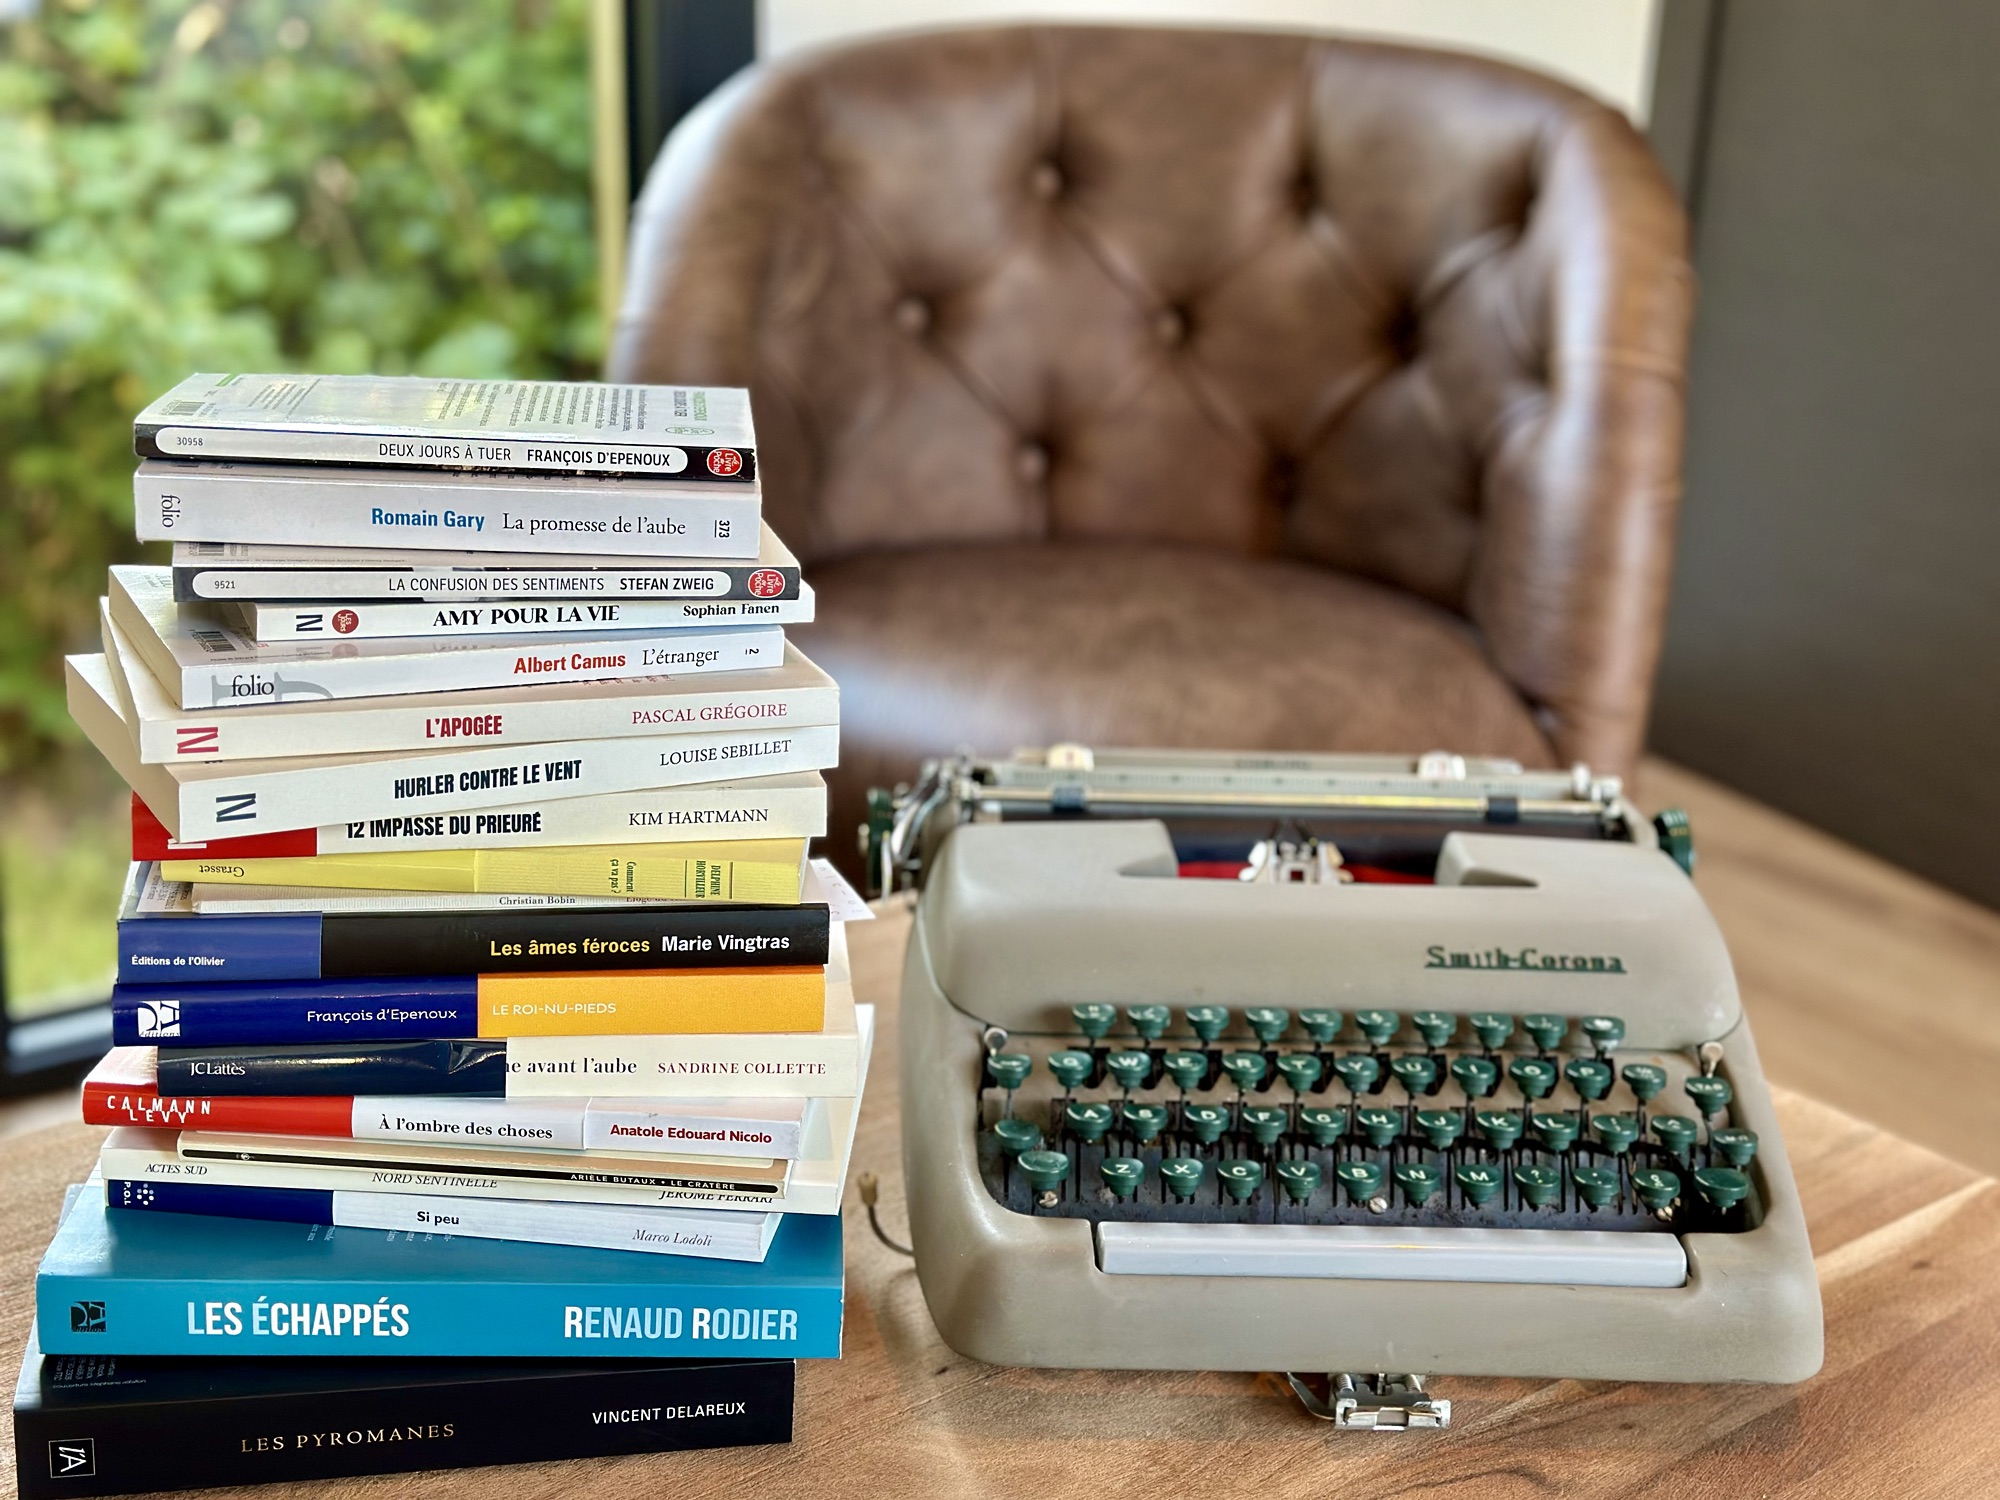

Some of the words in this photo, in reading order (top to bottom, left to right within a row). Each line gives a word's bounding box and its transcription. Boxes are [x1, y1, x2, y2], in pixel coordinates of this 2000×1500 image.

[176, 436, 204, 447] 30958
[379, 443, 414, 458] DEUX
[418, 445, 460, 459] JOURS
[464, 443, 474, 459] À
[478, 447, 511, 461] TUER
[527, 449, 593, 467] FRANÇOIS
[597, 450, 670, 467] D'EPENOUX
[713, 451, 723, 473] Poche
[724, 452, 734, 472] Livre
[161, 494, 181, 528] folio
[371, 507, 438, 527] Romain
[444, 510, 485, 532] Gary
[502, 513, 523, 530] La
[529, 518, 607, 536] promesse
[612, 515, 632, 533] de
[637, 516, 686, 535] l'aube
[717, 519, 730, 539] 373
[214, 580, 236, 590] 9521
[388, 578, 405, 591] LA
[410, 578, 488, 591] CONFUSION
[493, 578, 518, 591] DES
[523, 577, 605, 591] SENTIMENTS
[619, 577, 669, 591] STEFAN
[672, 577, 714, 591] ZWEIG
[754, 572, 764, 596] Poche
[766, 574, 777, 594] Livre
[433, 609, 484, 626] AMY
[490, 608, 549, 625] POUR
[557, 606, 583, 623] LA
[587, 605, 620, 622] VIE
[683, 604, 736, 619] Sophian
[741, 603, 780, 615] Fanen
[513, 656, 567, 674] Albert
[571, 653, 626, 670] Camus
[642, 648, 720, 667] L'étranger
[231, 674, 275, 697] folio
[632, 708, 696, 725] PASCAL
[700, 703, 787, 721] GRÉGOIRE
[426, 714, 502, 738] L'APOGÉE
[660, 748, 718, 766] LOUISE
[721, 739, 792, 759] SEBILLET
[394, 774, 455, 799] HURLER
[459, 767, 518, 791] CONTRE
[523, 764, 540, 784] LE
[545, 760, 582, 781] VENT
[346, 822, 365, 839] 12
[370, 816, 444, 838] IMPASSE
[449, 815, 471, 835] DU
[476, 811, 541, 834] PRIEURÉ
[629, 812, 663, 826] KIM
[668, 808, 769, 825] HARTMANN
[198, 864, 245, 878] Grasset
[626, 861, 637, 892] Comment
[711, 865, 721, 895] DELPHINE
[499, 896, 544, 906] Christian
[547, 895, 576, 905] Bobin
[490, 940, 522, 957] Les
[528, 939, 577, 955] âmes
[582, 937, 650, 954] féroces
[662, 935, 712, 951] Marie
[717, 934, 790, 953] Vingtras
[131, 953, 171, 966] Éditions
[173, 956, 186, 966] de
[188, 956, 225, 966] l'Olivier
[307, 1010, 373, 1024] François
[377, 1008, 457, 1023] d'Epenoux
[492, 1004, 509, 1016] LE
[513, 1003, 617, 1015] ROI-NU-PIEDS
[527, 1060, 577, 1073] avant
[583, 1058, 637, 1074] l'aube
[658, 1062, 740, 1074] SANDRINE
[744, 1062, 826, 1075] COLLETTE
[107, 1095, 211, 1115] CALMANN
[379, 1113, 391, 1130] À
[396, 1117, 460, 1134] l'ombre
[465, 1121, 493, 1136] des
[497, 1124, 553, 1139] choses
[610, 1124, 664, 1138] Anatole
[668, 1127, 726, 1141] Edouard
[729, 1130, 772, 1144] Nicolo
[145, 1163, 181, 1174] ACTES
[184, 1165, 208, 1176] SUD
[372, 1172, 412, 1184] NORD
[415, 1174, 498, 1188] SENTINELLE
[613, 1176, 656, 1186] BUTAUX
[670, 1179, 682, 1187] LE
[688, 1181, 735, 1190] CRATÈRE
[417, 1211, 430, 1223] Si
[434, 1213, 460, 1225] peu
[632, 1229, 670, 1243] Marco
[673, 1232, 713, 1247] Lodoli
[188, 1302, 243, 1336] LES
[253, 1296, 409, 1337] ÉCHAPPÉS
[564, 1306, 683, 1339] RENAUD
[692, 1308, 798, 1341] RODIER
[592, 1407, 661, 1425] VINCENT
[666, 1401, 746, 1420] DELAREUX
[241, 1436, 284, 1453] LES
[297, 1424, 455, 1449] PYROMANES
